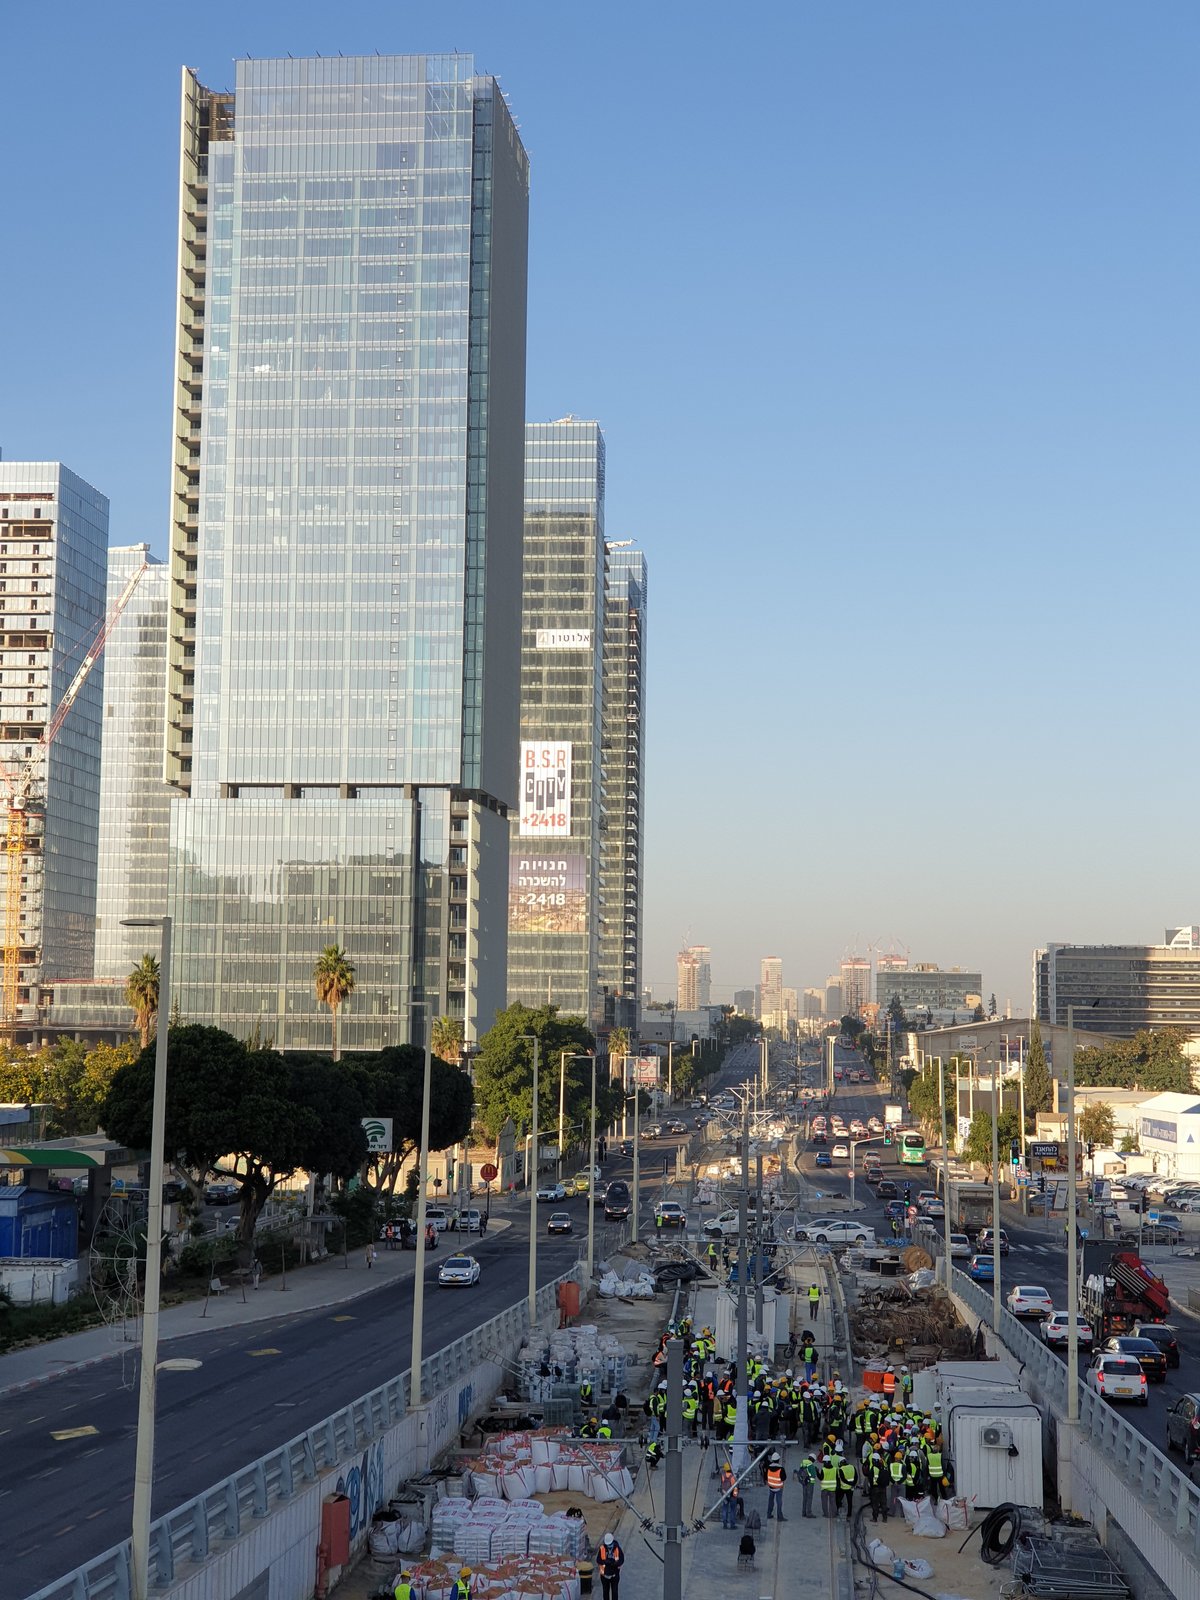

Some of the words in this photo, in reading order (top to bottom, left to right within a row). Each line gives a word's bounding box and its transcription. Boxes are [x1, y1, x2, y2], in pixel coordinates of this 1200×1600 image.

[552, 633, 589, 644] אלוטון
[526, 750, 566, 768] B.S.R
[527, 777, 565, 794] CITY
[519, 860, 567, 871] חנויות
[518, 874, 566, 887] להשכרה
